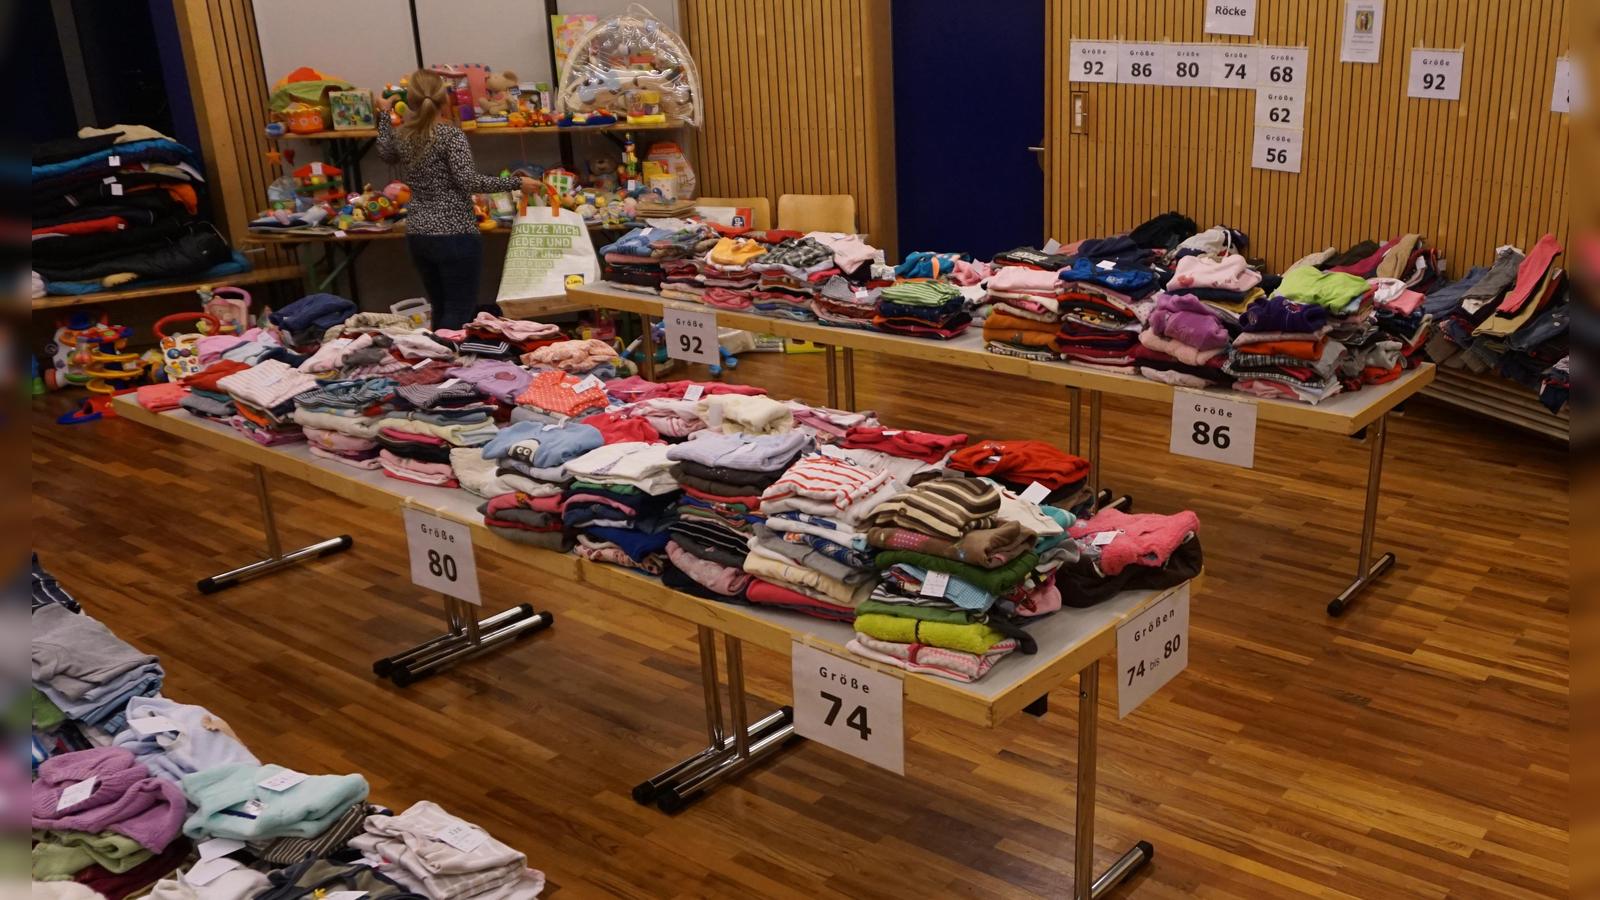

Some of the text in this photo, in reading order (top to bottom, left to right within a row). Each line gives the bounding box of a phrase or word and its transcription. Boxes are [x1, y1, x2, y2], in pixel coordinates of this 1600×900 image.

[1215, 5, 1247, 17] Röcke
[1224, 51, 1248, 59] Größe
[1422, 58, 1450, 66] Größe
[1083, 60, 1104, 76] 92
[1131, 62, 1153, 78] 86
[1176, 62, 1200, 78] 80
[1224, 63, 1247, 80] 74
[1269, 66, 1293, 83] 68
[1423, 73, 1446, 91] 92
[1267, 94, 1294, 102] Größe
[1269, 107, 1291, 123] 62
[1265, 134, 1291, 143] Größe
[1266, 148, 1288, 164] 56
[512, 224, 580, 236] NUTZE MICH
[509, 237, 570, 247] IEDER UND
[675, 317, 704, 329] Größe
[679, 334, 704, 355] 92
[1194, 404, 1233, 418] Größe
[1191, 420, 1231, 450] 86
[420, 522, 456, 544] Größe
[427, 548, 458, 583] 80
[1134, 608, 1176, 642] Größen
[1126, 633, 1182, 687] 74 bis 80
[819, 666, 871, 694] Größe
[819, 690, 872, 742] 74
